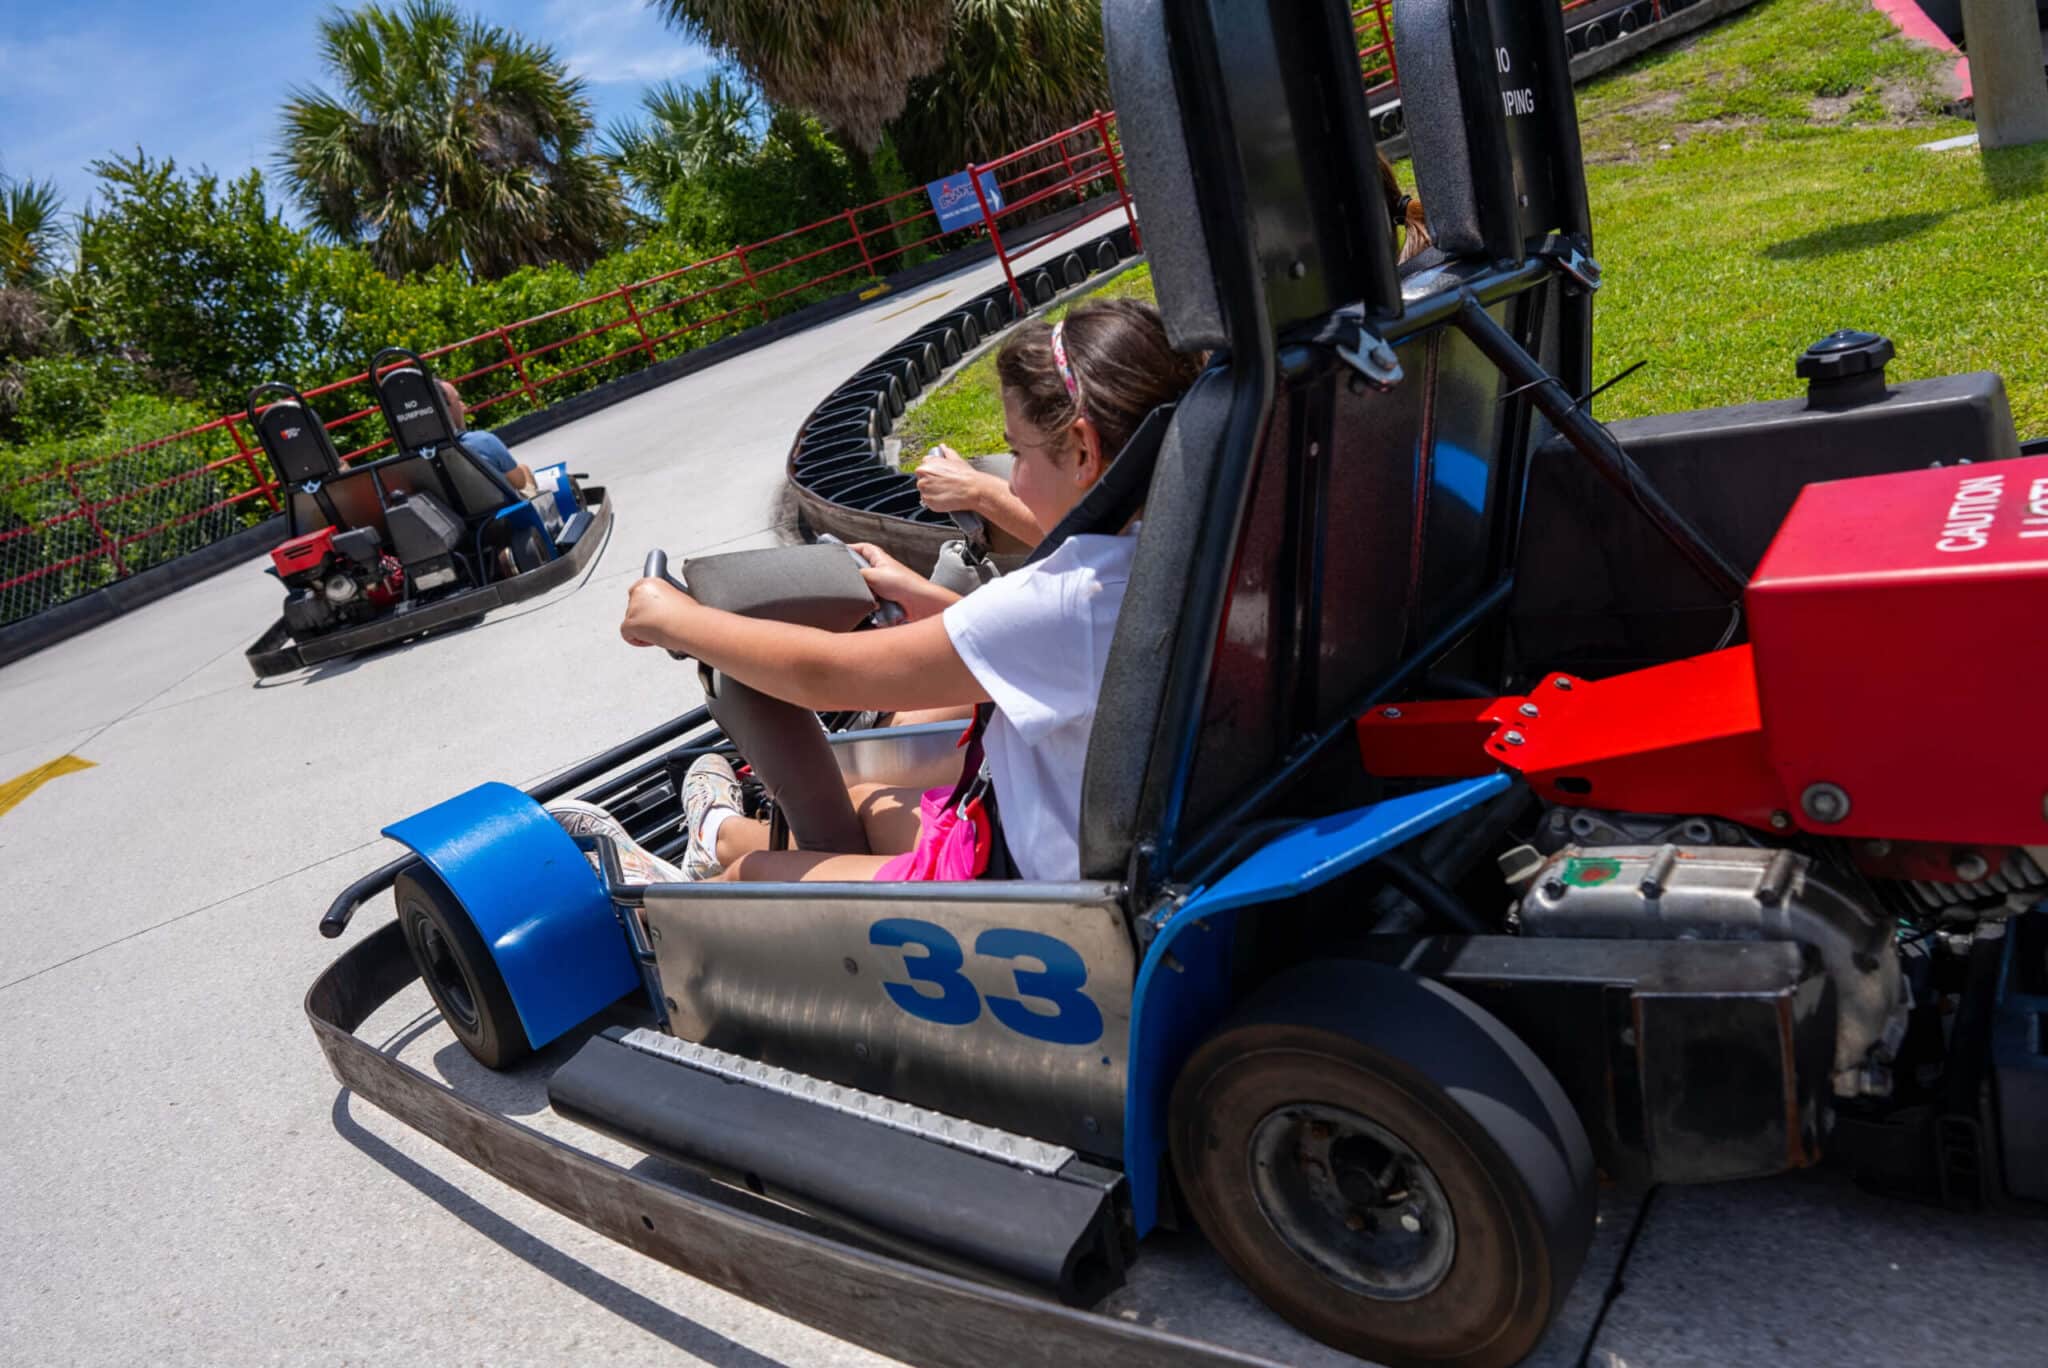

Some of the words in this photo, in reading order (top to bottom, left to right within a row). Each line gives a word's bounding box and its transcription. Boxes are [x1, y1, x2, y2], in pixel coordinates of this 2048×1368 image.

[1502, 88, 1535, 117] PING
[404, 400, 418, 409] NO
[1935, 474, 2005, 552] CAUTION
[868, 917, 1104, 1046] 33
